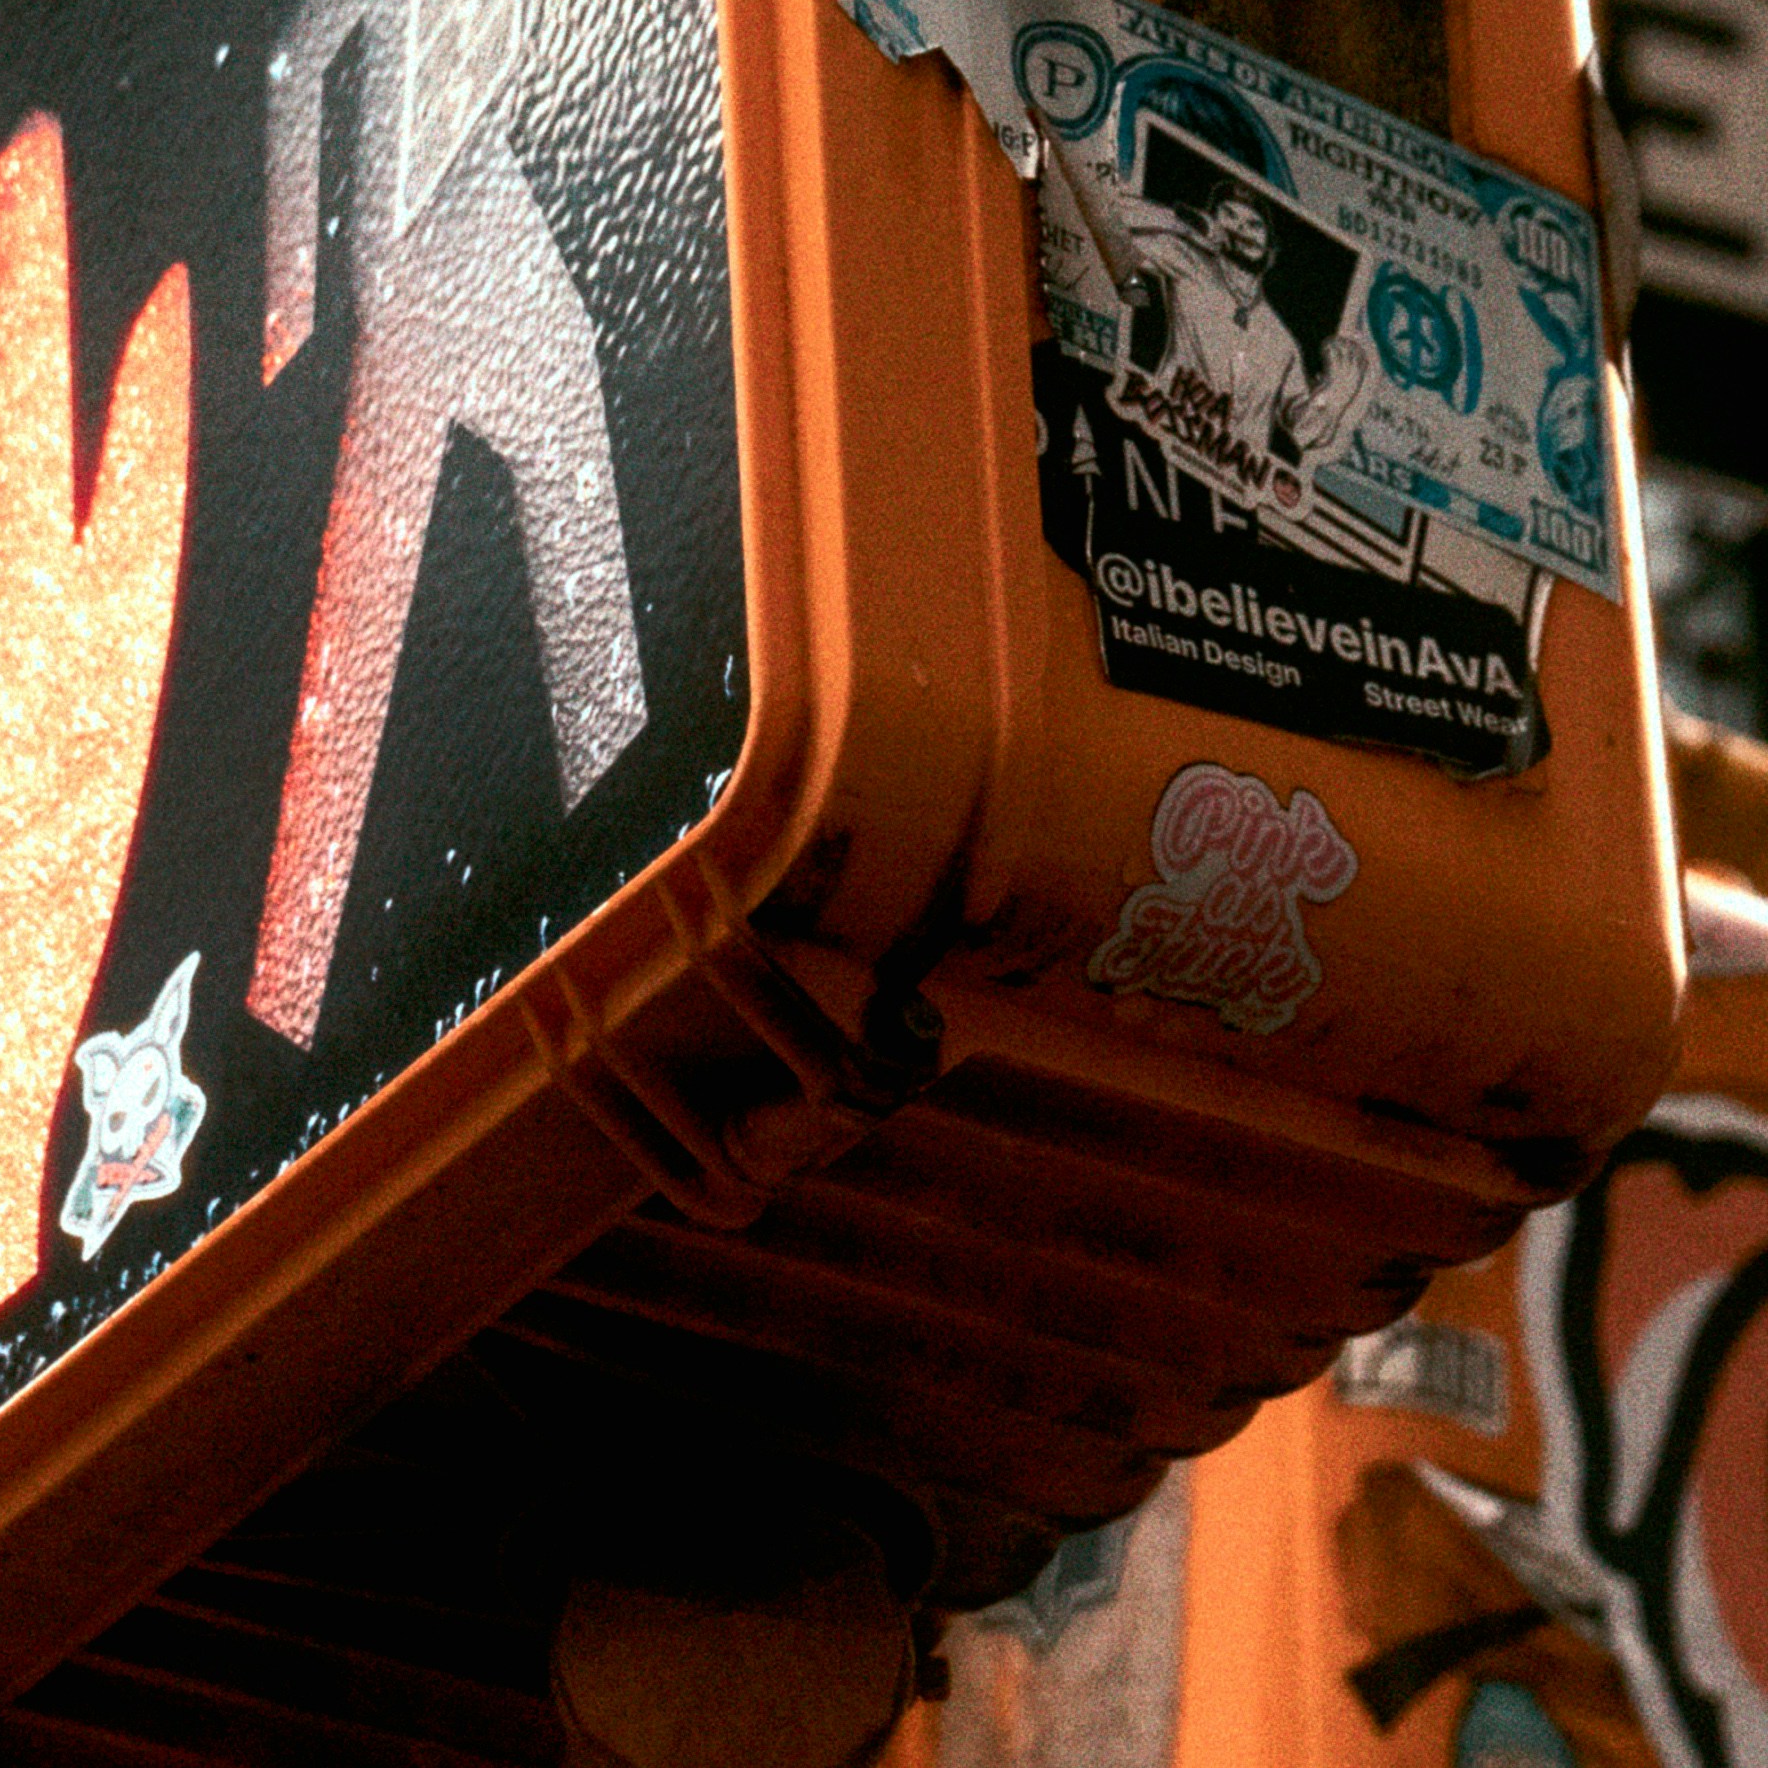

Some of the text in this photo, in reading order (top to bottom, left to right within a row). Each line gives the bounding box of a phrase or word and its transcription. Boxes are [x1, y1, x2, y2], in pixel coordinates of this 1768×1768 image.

[1042, 58, 1087, 99] P
[1234, 60, 1274, 99] OF
[1284, 81, 1451, 178] AMERICA
[1479, 436, 1505, 468] 23
[1096, 551, 1524, 700] @ibelieveinAvA
[1110, 614, 1302, 688] Italian Design
[1362, 680, 1451, 722] Street
